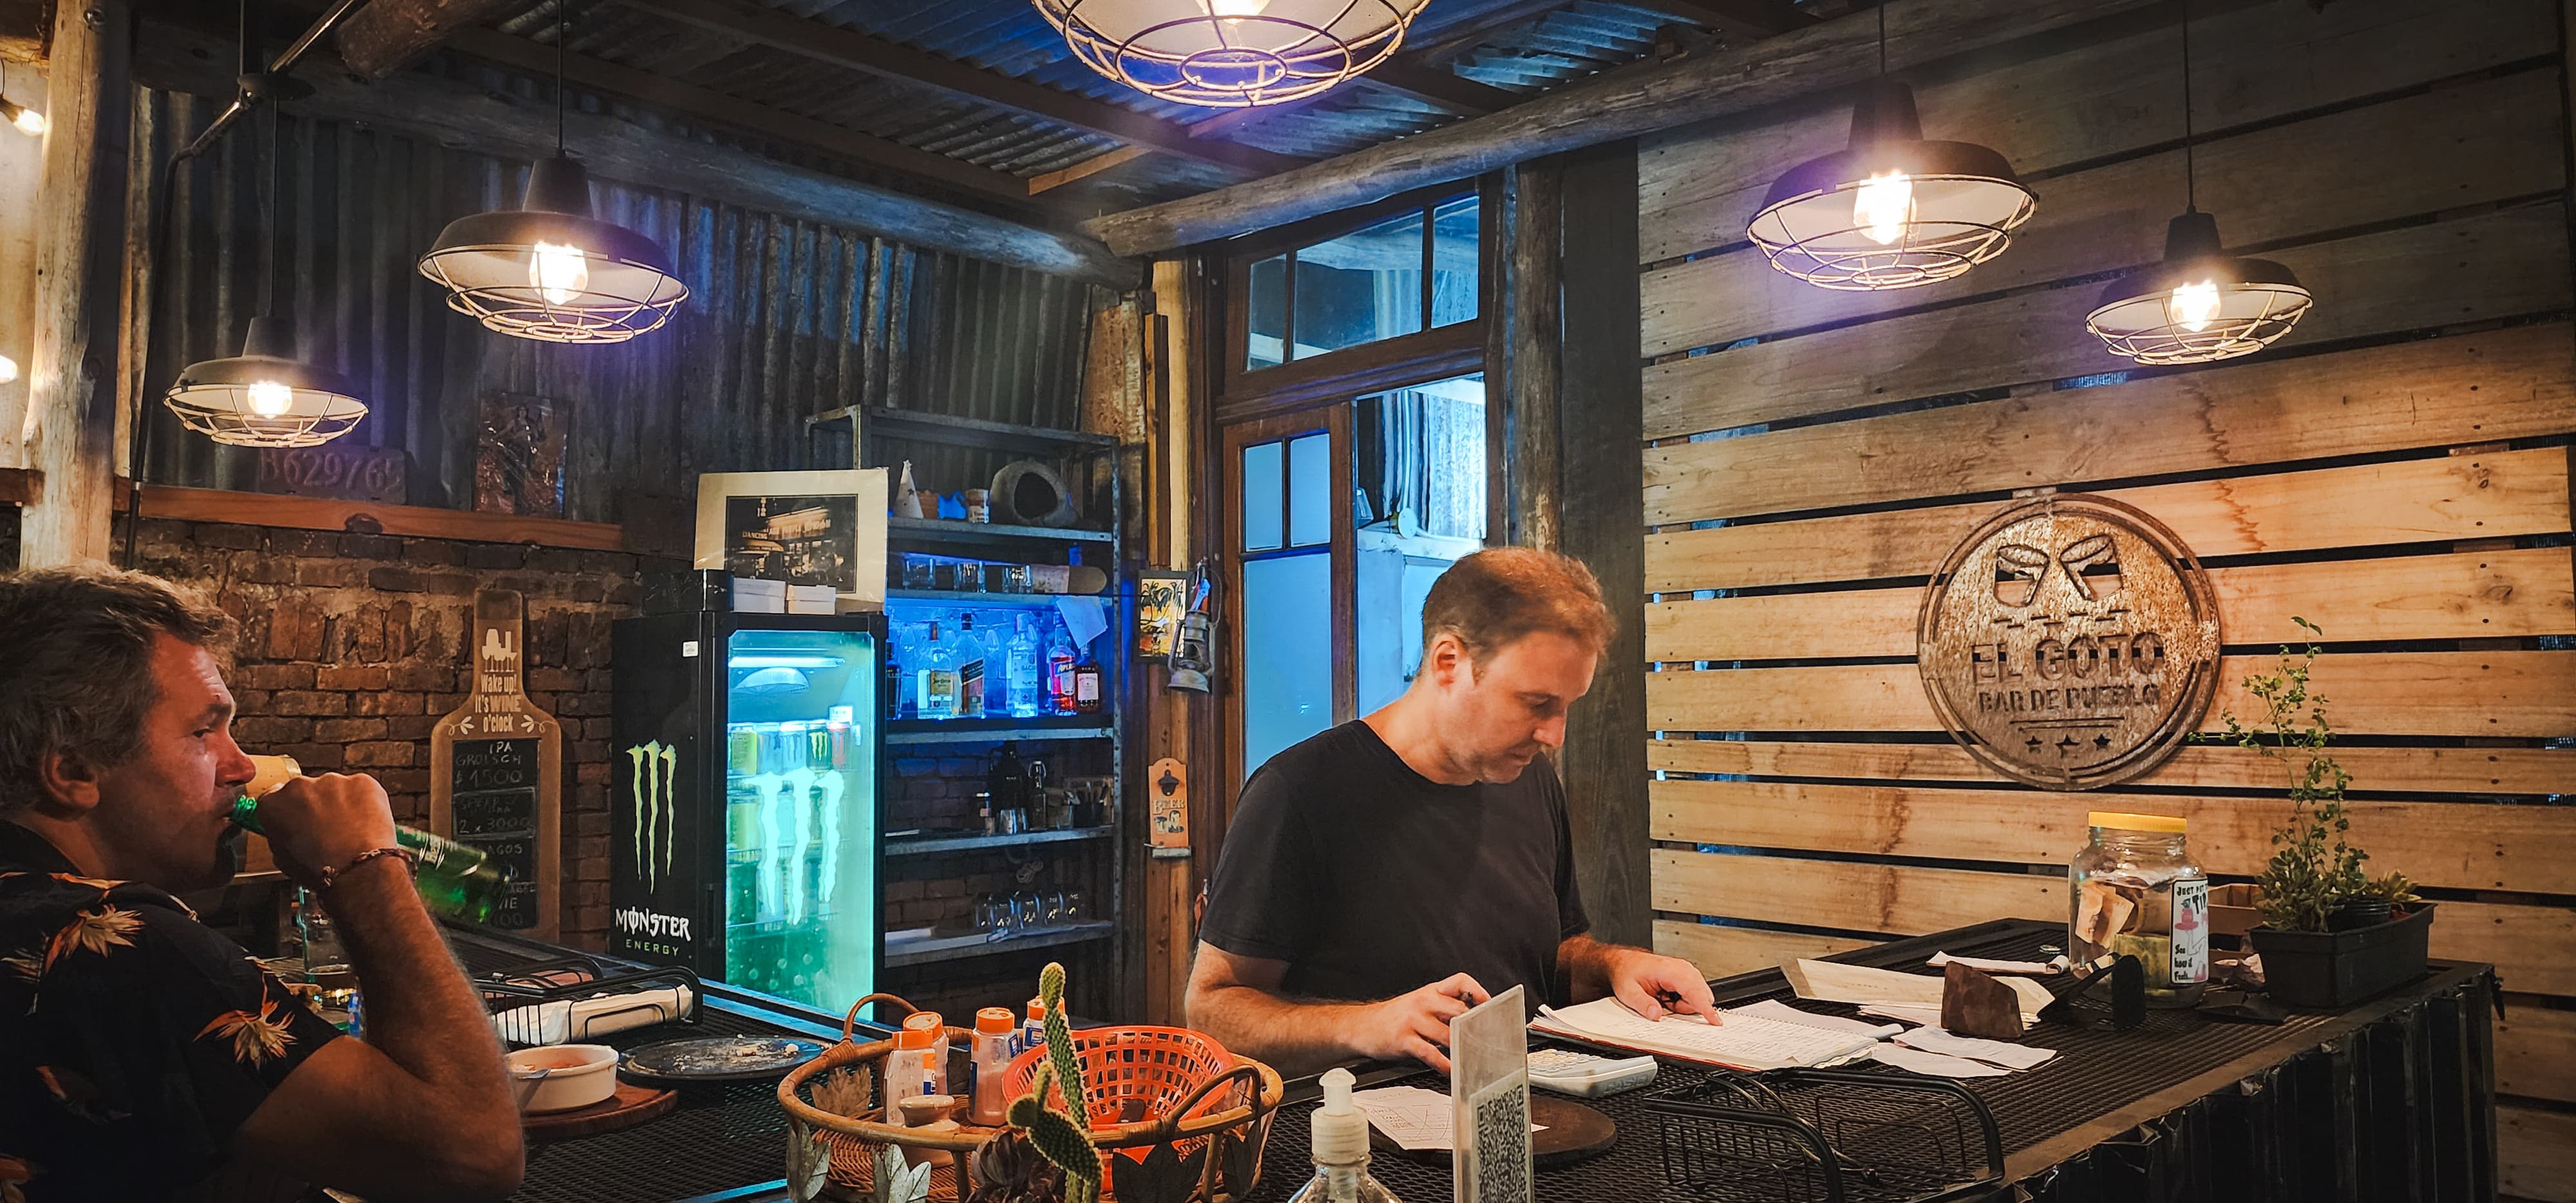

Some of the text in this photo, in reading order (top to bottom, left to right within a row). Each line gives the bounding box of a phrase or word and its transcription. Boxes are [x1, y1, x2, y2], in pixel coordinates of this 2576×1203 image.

[1971, 632, 2164, 683] EL GOTO
[481, 674, 517, 695] Wake up!
[475, 694, 522, 713] It's WINE
[1978, 683, 2159, 712] BAR DE PUEBLO
[483, 713, 513, 733] o'clock
[489, 741, 513, 754] IPA
[455, 753, 522, 766] GROLSCH
[1152, 799, 1185, 815] BEER
[2177, 886, 2194, 896] JUST
[626, 939, 679, 956] ENERGY
[2175, 944, 2186, 954] See
[2174, 957, 2193, 968] how it
